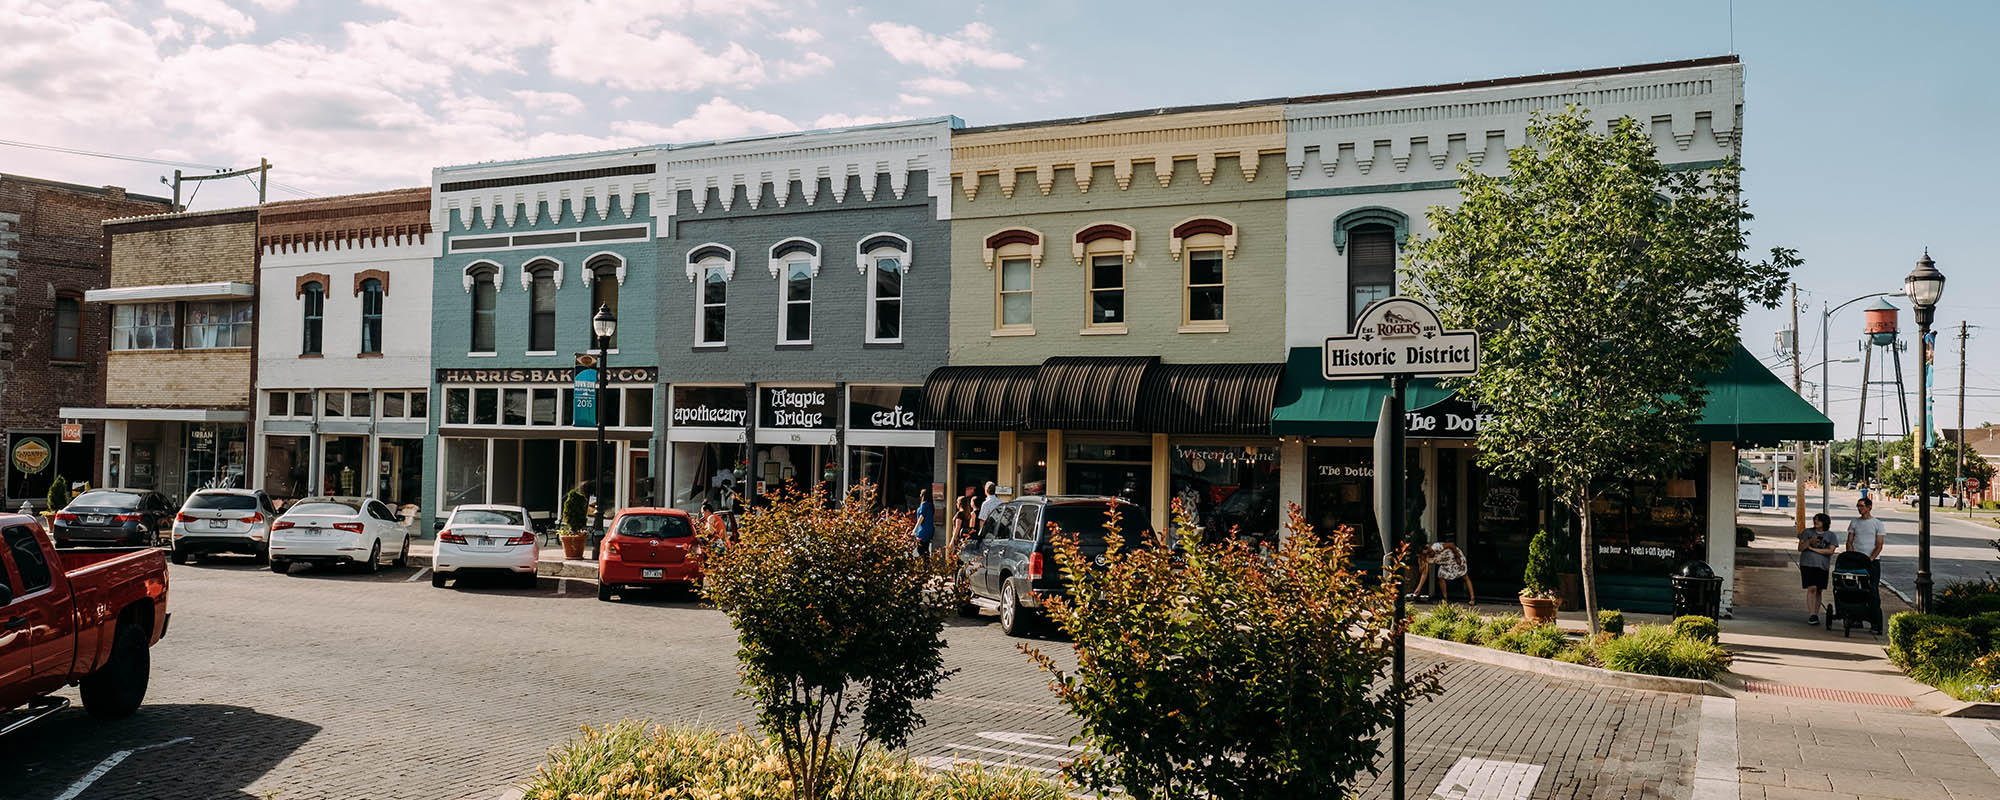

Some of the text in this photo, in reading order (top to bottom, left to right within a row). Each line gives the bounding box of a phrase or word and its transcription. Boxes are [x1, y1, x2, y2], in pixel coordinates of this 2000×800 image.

[1377, 321, 1421, 336] ROGERS
[1332, 345, 1470, 367] Historic District
[447, 370, 524, 382] HARRIS
[771, 389, 825, 408] Magpie
[674, 403, 747, 426] apothecary
[774, 409, 822, 427] Bridge
[871, 404, 914, 428] cafe
[64, 428, 81, 438] YOGA
[1178, 447, 1274, 461] Wisteria Lane
[1319, 465, 1374, 477] The Dotte
[1657, 547, 1675, 559] Registry
